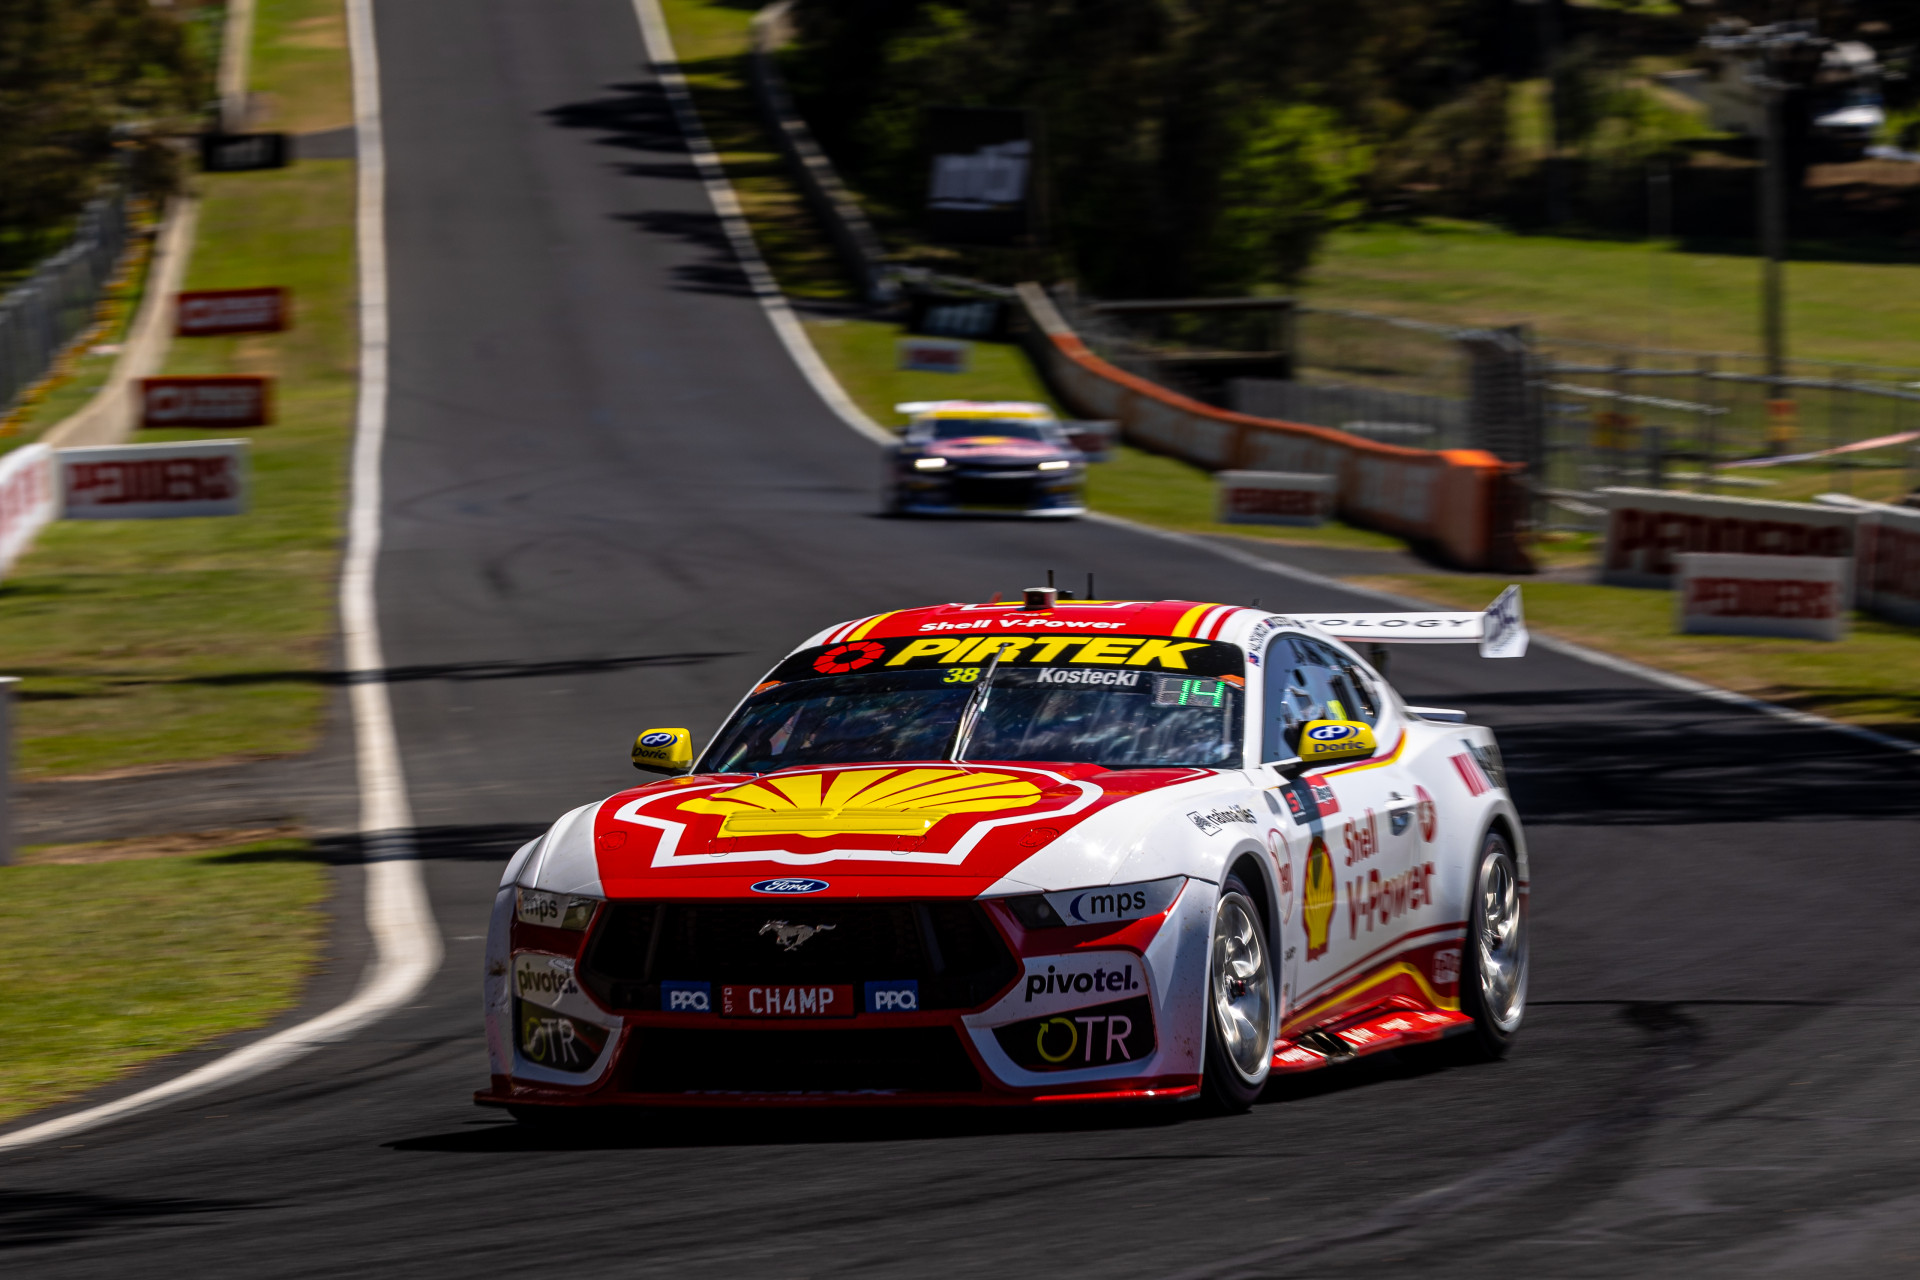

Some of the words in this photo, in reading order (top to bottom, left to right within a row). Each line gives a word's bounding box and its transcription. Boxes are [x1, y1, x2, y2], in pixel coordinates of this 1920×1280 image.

[918, 619, 992, 632] Shell
[999, 618, 1126, 629] V-Power
[884, 636, 1211, 669] PIRTEK
[943, 667, 981, 683] 38
[1036, 667, 1141, 687] Kostecki
[1177, 679, 1226, 708] 14
[632, 747, 667, 759] Doric
[1314, 740, 1366, 753] Doric
[1343, 808, 1380, 867] Shell
[764, 879, 813, 893] Ford
[1090, 890, 1147, 917] mps
[1344, 861, 1436, 941] V-Power
[1025, 964, 1139, 1003] pivotel.
[670, 990, 710, 1011] PPQ
[748, 986, 835, 1015] CH4MP
[875, 989, 917, 1011] PPQ
[525, 1016, 580, 1063] OTR
[1036, 1014, 1133, 1063] OTR
